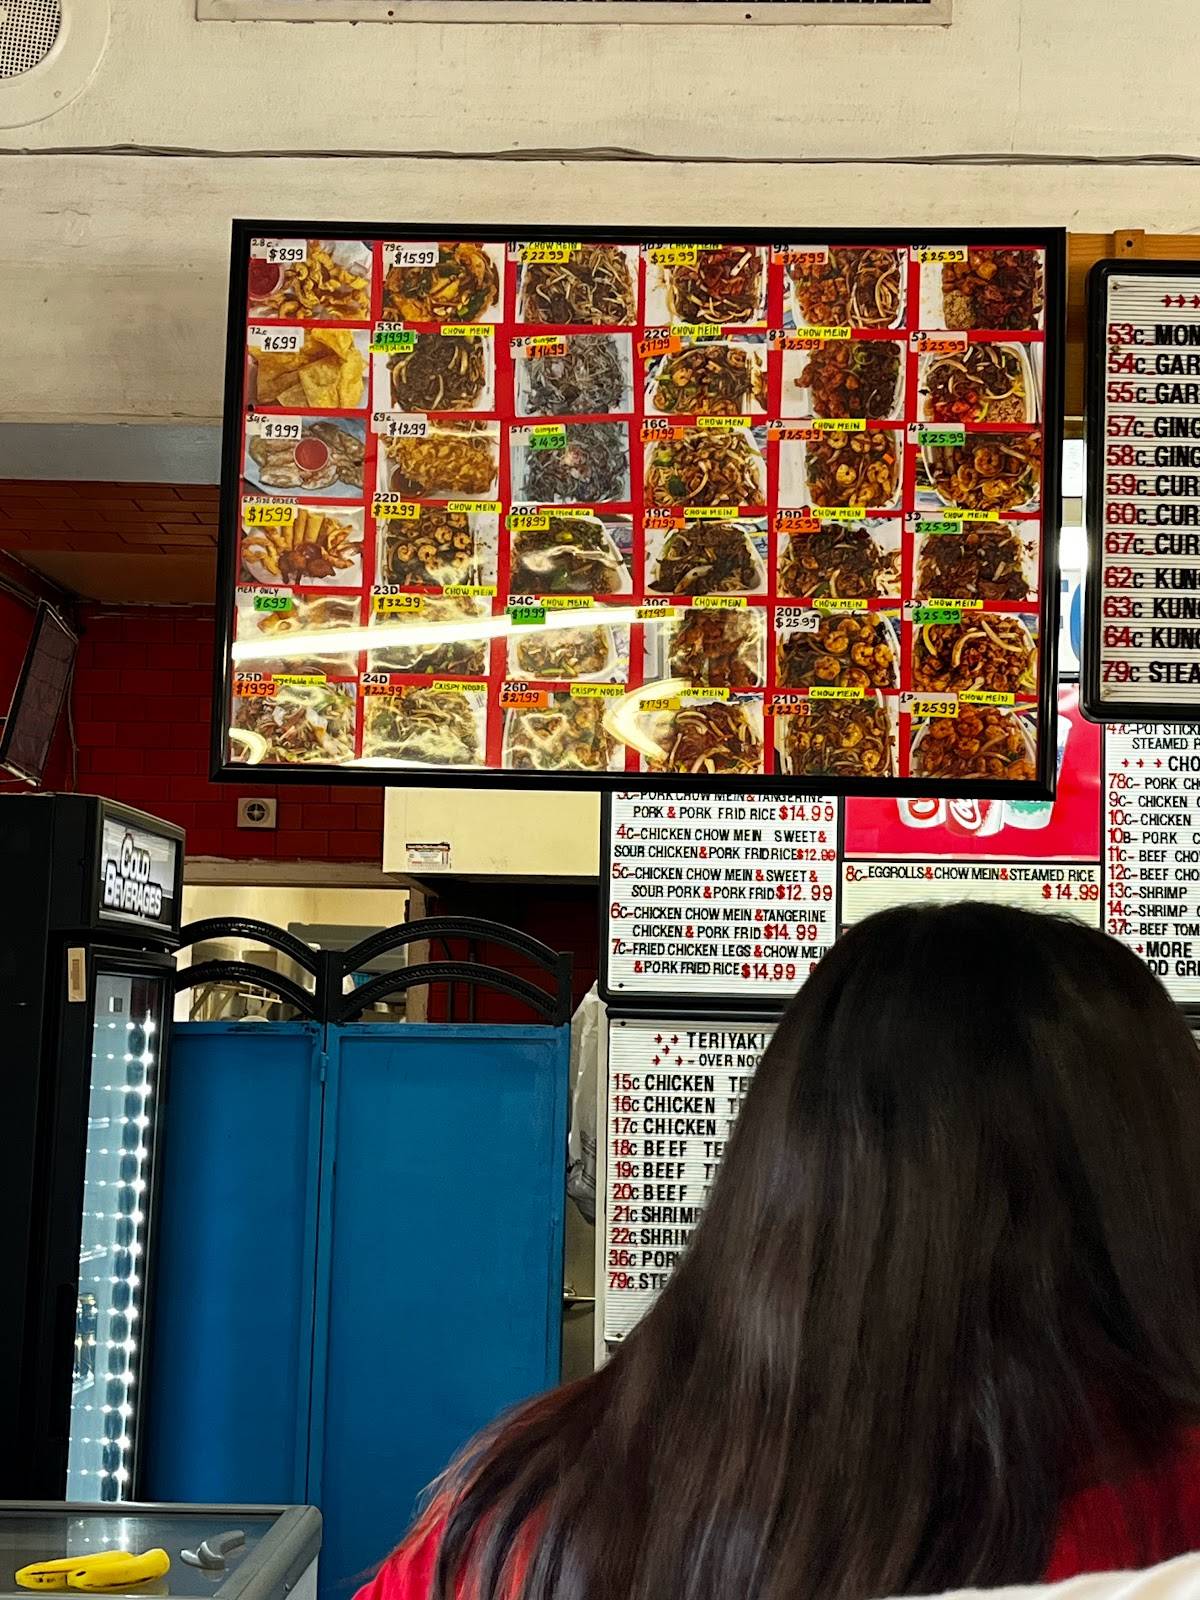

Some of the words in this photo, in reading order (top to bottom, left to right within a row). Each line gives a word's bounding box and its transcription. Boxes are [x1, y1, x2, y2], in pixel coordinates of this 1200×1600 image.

[377, 323, 401, 331] 53C
[442, 327, 466, 335] CHOW
[469, 327, 490, 335] MEIN
[672, 326, 695, 335] CHOW
[697, 326, 719, 335] MEIN
[645, 330, 669, 340] 22C
[643, 419, 667, 428] 16C
[375, 494, 398, 502] 22D
[449, 503, 472, 511] CHOW
[709, 508, 733, 516] MEIN
[646, 509, 670, 518] 19C
[1155, 568, 1200, 590] KUN
[237, 586, 257, 594] MEAT
[374, 586, 398, 594] 23D
[445, 587, 468, 595] CHOW
[472, 588, 494, 596] MEIN
[508, 596, 533, 605] 54C
[541, 598, 564, 606] CHOW
[567, 598, 590, 606] MEIN
[954, 599, 976, 607] MEIN
[777, 608, 801, 616] 20D
[237, 673, 261, 681] 25D
[363, 674, 388, 683] 24D
[504, 683, 528, 691] 26D
[774, 695, 798, 703] 21D
[837, 690, 860, 698] MEIN
[960, 693, 984, 701] CHOW
[985, 694, 1008, 702] MEIN
[1132, 738, 1189, 750] STEAMED
[1145, 777, 1177, 789] PORK
[1138, 796, 1188, 808] CHICKEN
[633, 806, 664, 818] PORK
[666, 806, 676, 818] &
[679, 806, 712, 819] PORK
[718, 807, 746, 820] FRID
[750, 808, 776, 821] RICE
[779, 806, 834, 822] $14.99
[694, 828, 729, 841] CHOW
[733, 829, 762, 842] MEIN
[774, 830, 817, 843] SWEET
[817, 830, 827, 843] &
[1142, 832, 1177, 844] PORK
[120, 834, 150, 883] COLD
[614, 845, 644, 857] SOUR
[648, 846, 697, 859] CHICKEN
[708, 847, 740, 859] PORK
[771, 849, 797, 861] RICE
[1139, 850, 1167, 862] BEEF
[686, 868, 721, 880] CHOW
[725, 869, 753, 881] MEIN
[755, 869, 764, 881] &
[766, 870, 807, 882] SWEET
[934, 868, 969, 880] CHOW
[972, 868, 1000, 880] MEIN
[1009, 869, 1065, 882] STEAMED
[1068, 869, 1095, 882] RICE
[104, 860, 162, 919] BEVERAGES
[631, 885, 664, 898] SOUR
[667, 886, 700, 899] PORK
[713, 887, 746, 899] PORK
[749, 887, 775, 900] FRID
[1042, 884, 1099, 900] $14.99
[685, 907, 720, 920] CHOW
[723, 908, 752, 921] MEIN
[763, 909, 826, 922] TANGERINE
[632, 925, 683, 938] CHICKEN
[685, 925, 694, 938] &
[697, 926, 730, 939] PORK
[734, 927, 761, 939] FRID
[667, 943, 718, 956] CHICKEN
[722, 944, 751, 957] LEGS
[763, 945, 799, 958] CHOW
[1146, 942, 1192, 958] MORE
[644, 961, 677, 974] PORK
[680, 961, 710, 974] FRIED
[713, 963, 739, 975] RICE
[741, 963, 796, 981] $14.99
[687, 1032, 765, 1049] TERIYAKI
[699, 1054, 733, 1067] OVER
[645, 1074, 714, 1092] CHICKEN
[644, 1096, 715, 1113] CHICKEN
[644, 1118, 716, 1135] CHICKEN
[644, 1140, 687, 1157] BEEF
[643, 1162, 686, 1179] BEEF
[643, 1184, 688, 1201] BEEF
